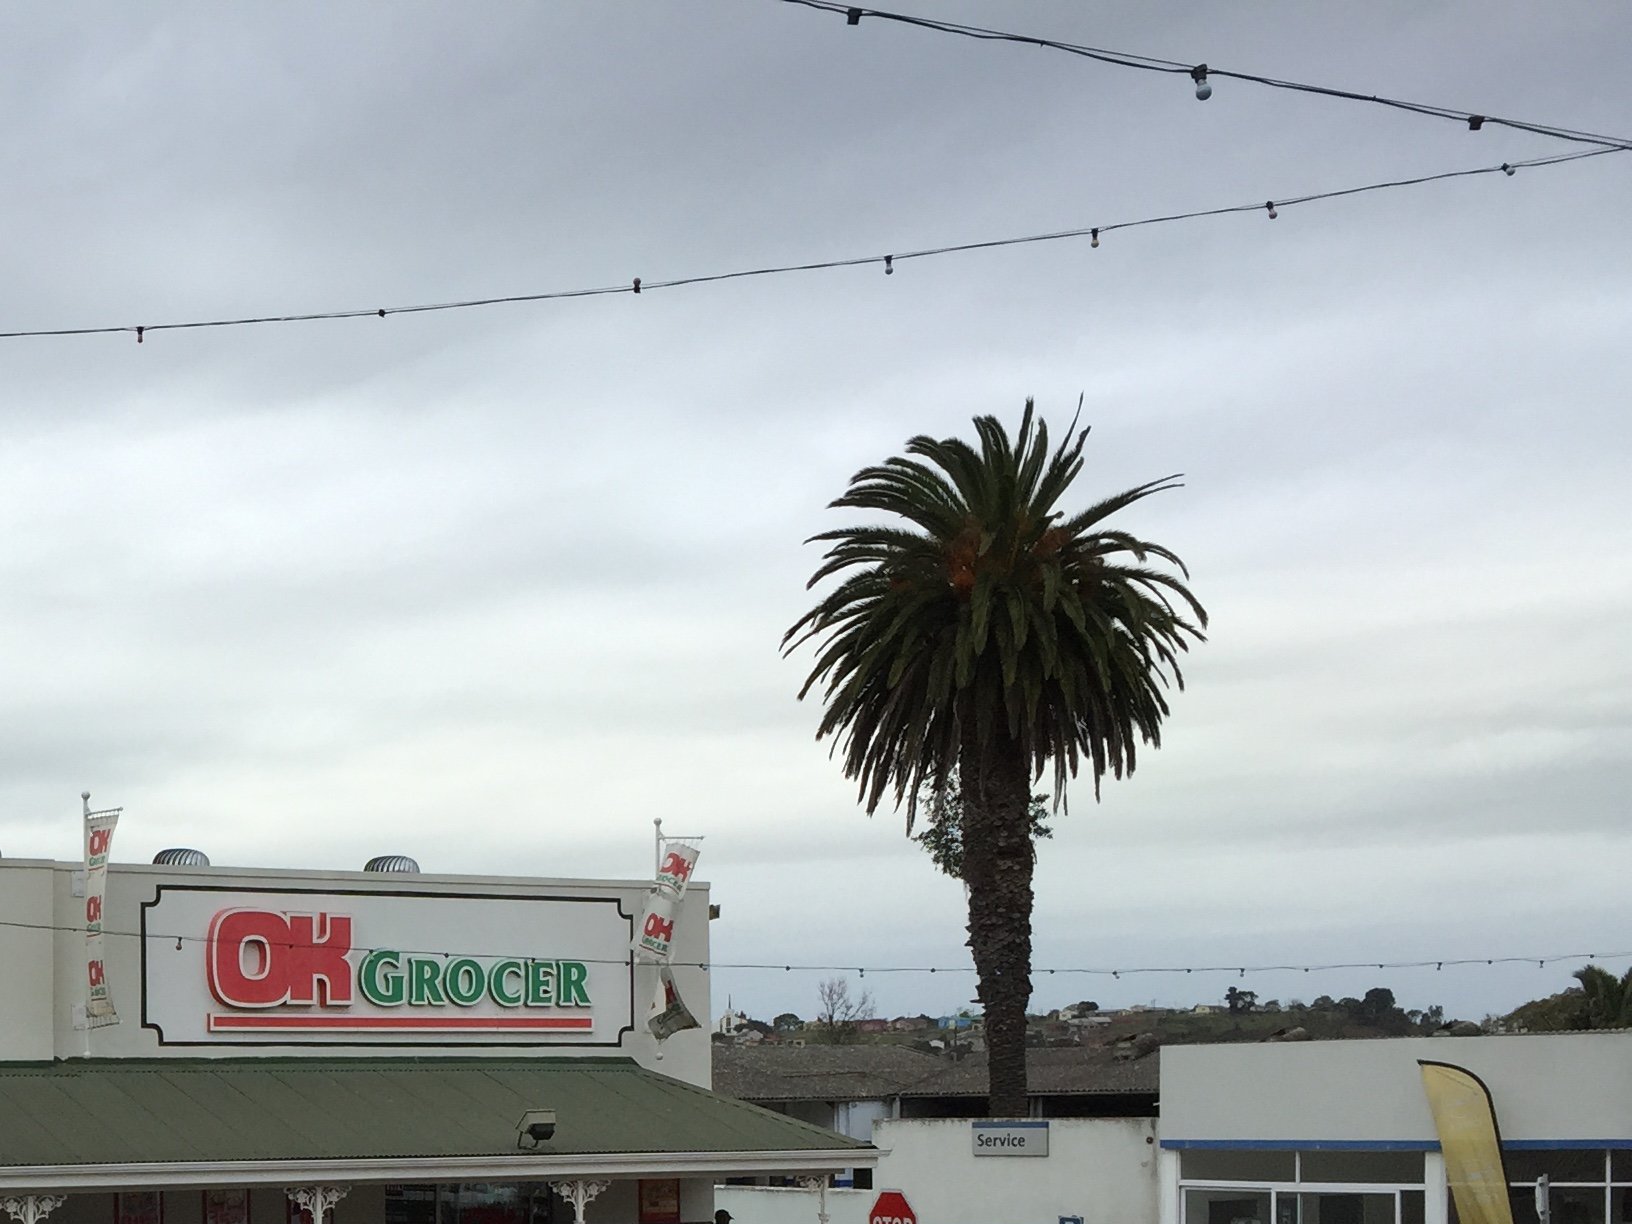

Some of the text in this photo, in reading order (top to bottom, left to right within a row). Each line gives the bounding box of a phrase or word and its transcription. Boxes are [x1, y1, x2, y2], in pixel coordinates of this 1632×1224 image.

[206, 906, 593, 1010] OK GROCER
[976, 1132, 1026, 1148] Service
